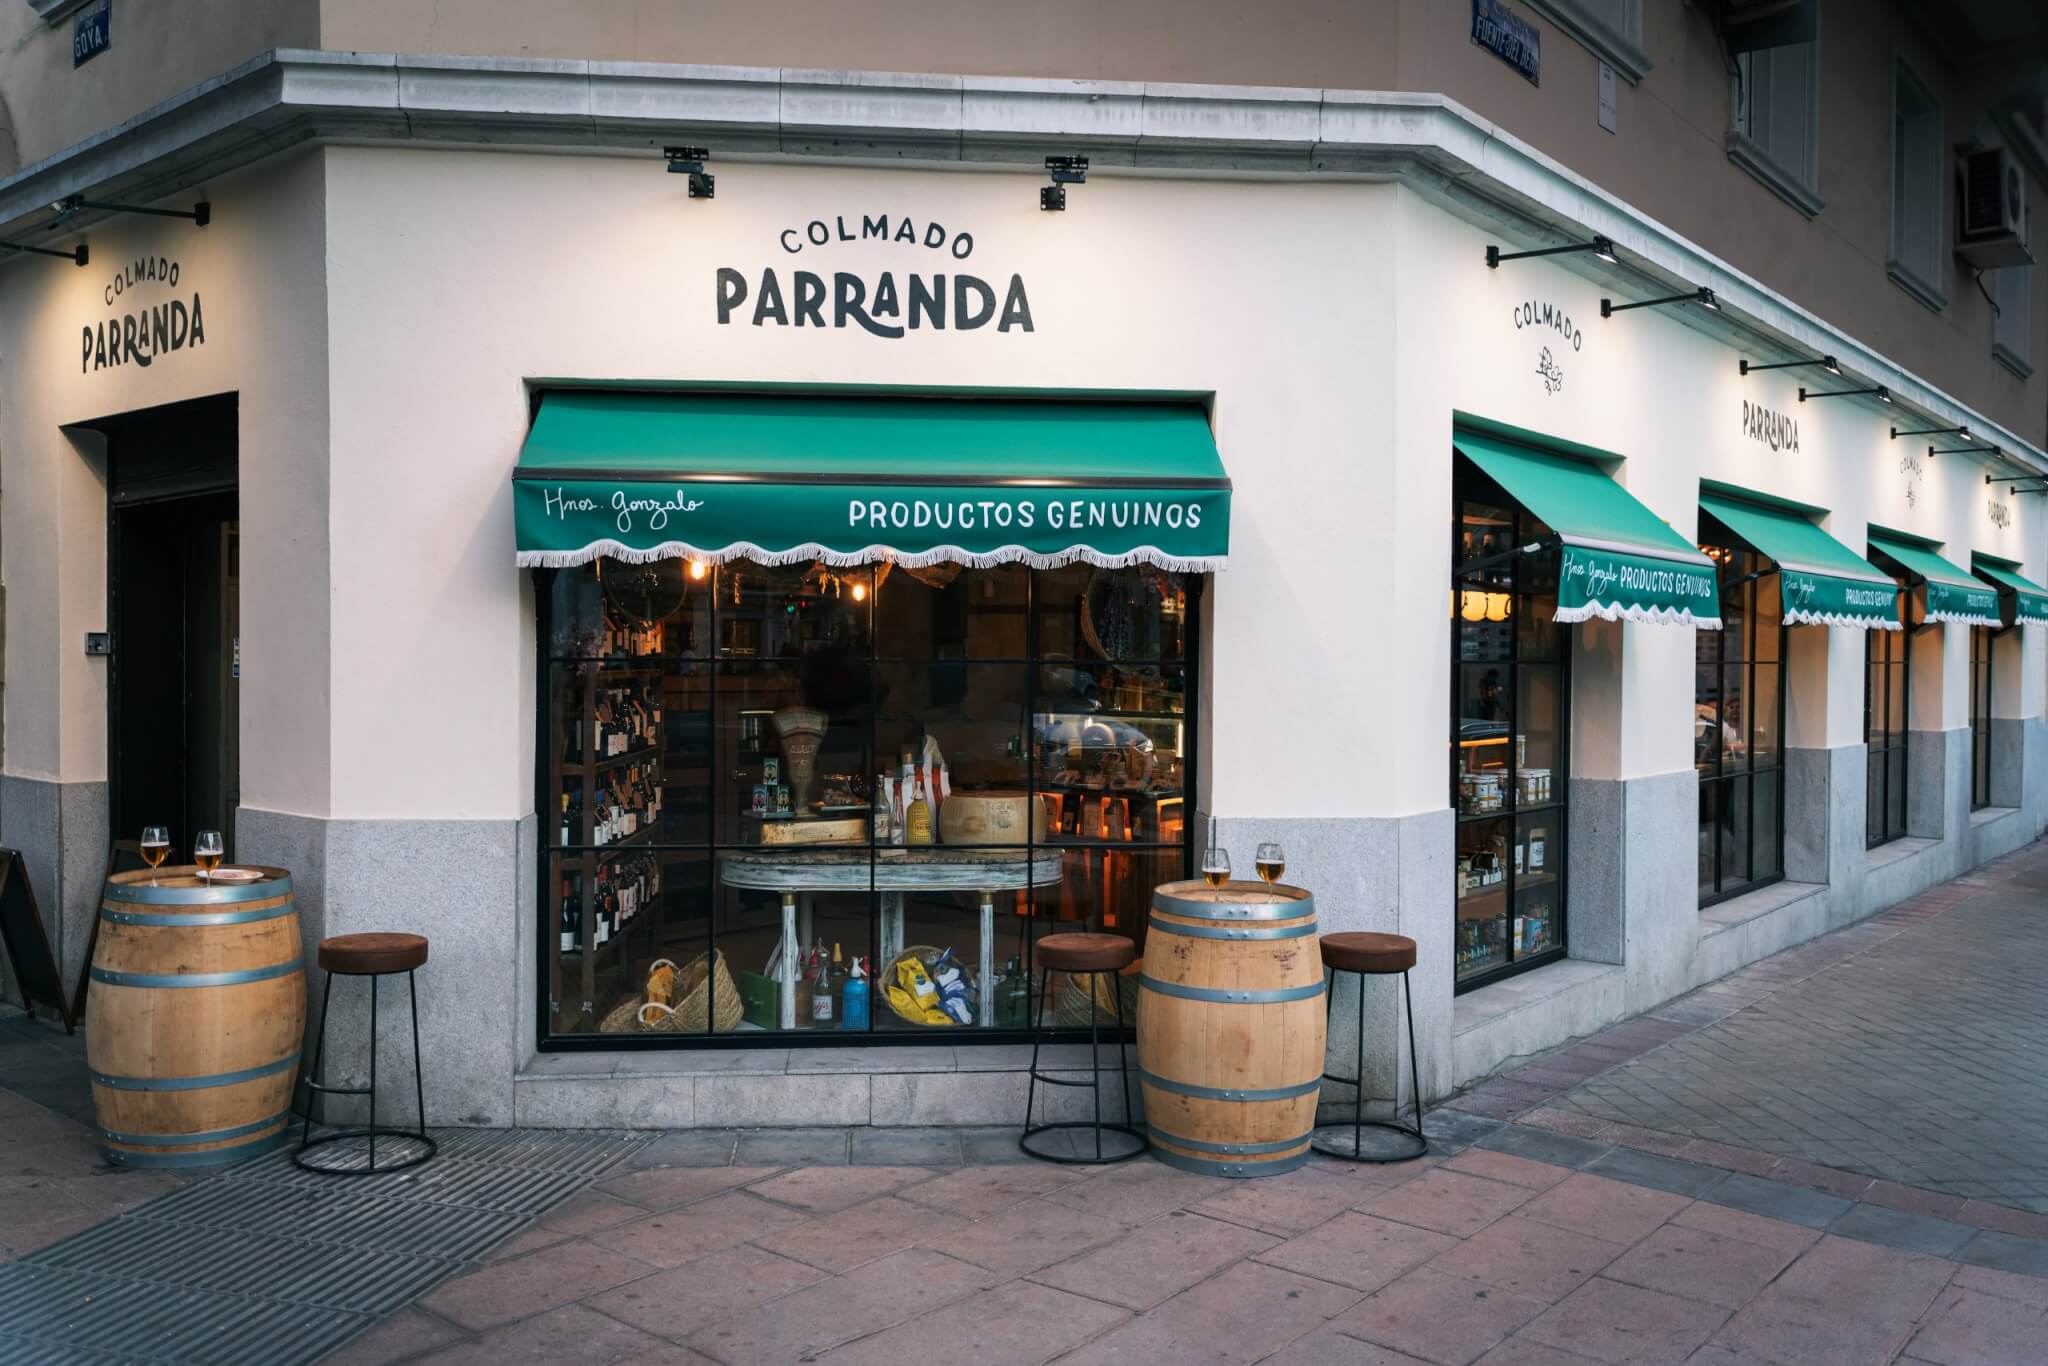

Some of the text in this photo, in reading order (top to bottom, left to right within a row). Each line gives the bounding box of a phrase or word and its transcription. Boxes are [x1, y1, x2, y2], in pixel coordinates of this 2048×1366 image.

[75, 25, 103, 57] GOYA
[780, 214, 973, 261] COLMADO
[105, 257, 180, 307] COLMADO
[716, 267, 1036, 339] PARRANDA
[82, 292, 206, 375] PARRANDA
[1514, 300, 1582, 353] COLMADO
[1743, 400, 1800, 454] PARRANDA
[849, 500, 1202, 530] PRODUCTOS GENUINOS
[1620, 565, 1674, 593] PRODUCTOS
